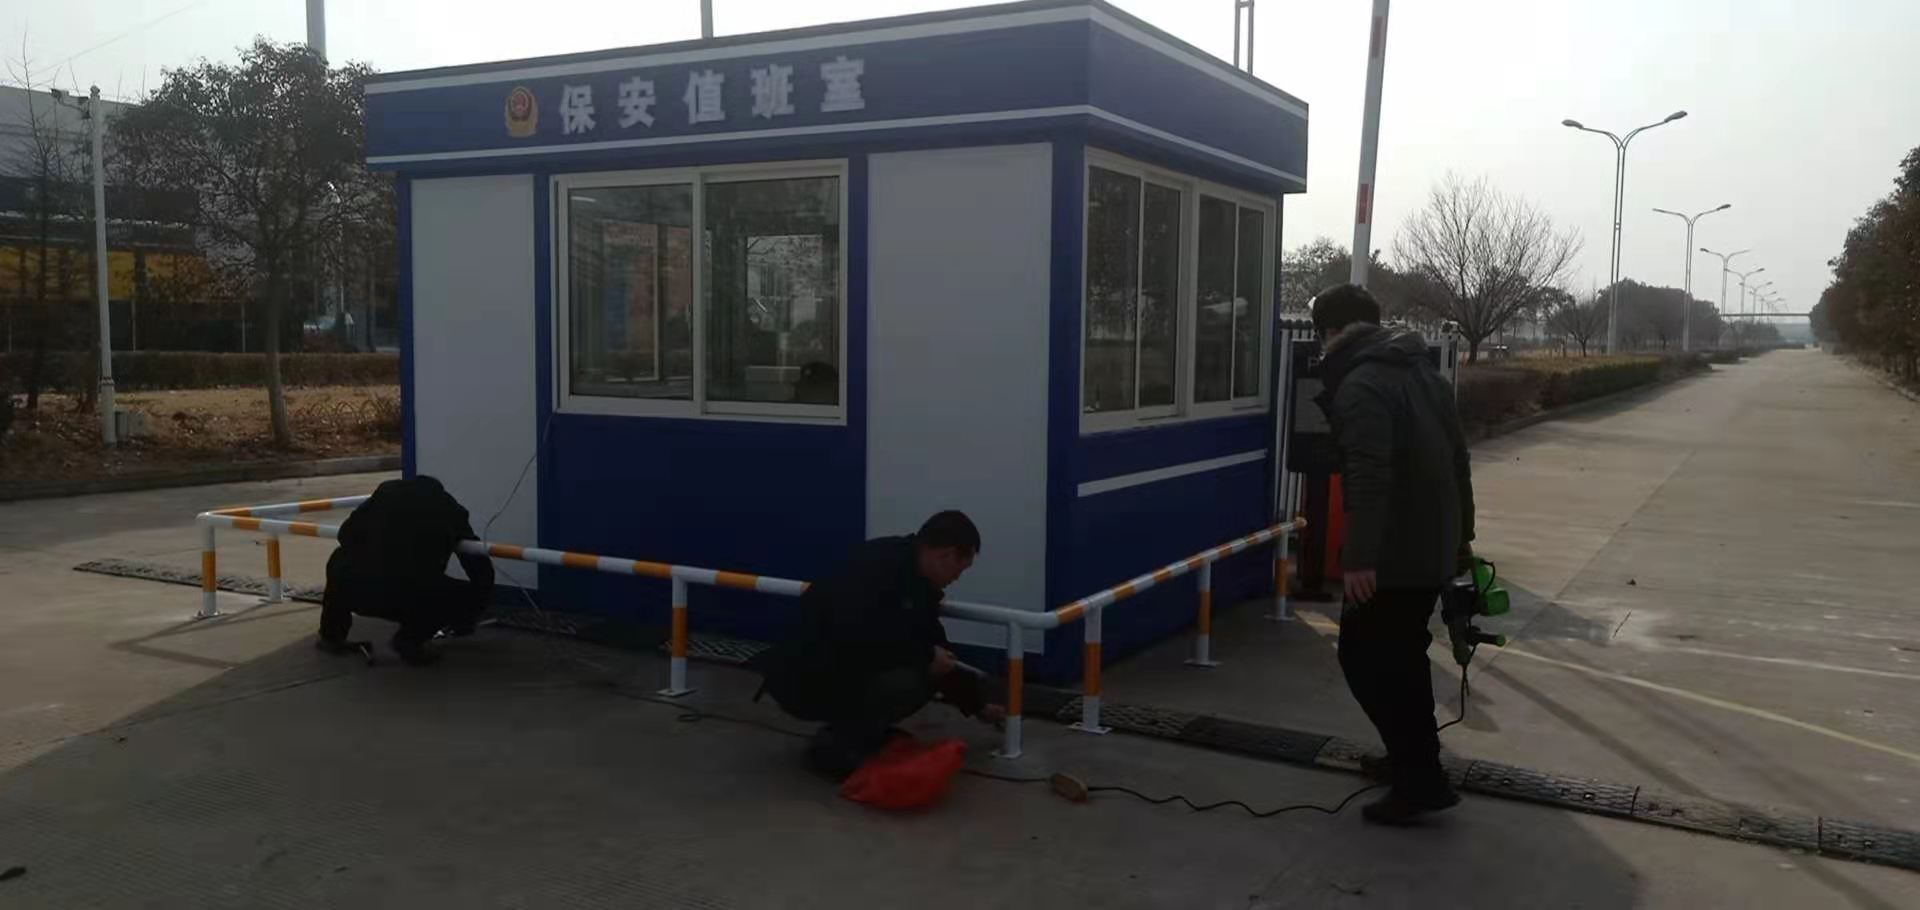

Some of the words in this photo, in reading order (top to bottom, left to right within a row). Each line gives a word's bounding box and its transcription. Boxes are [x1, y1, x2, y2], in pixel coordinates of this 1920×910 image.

[560, 55, 865, 135] 保安值班室
